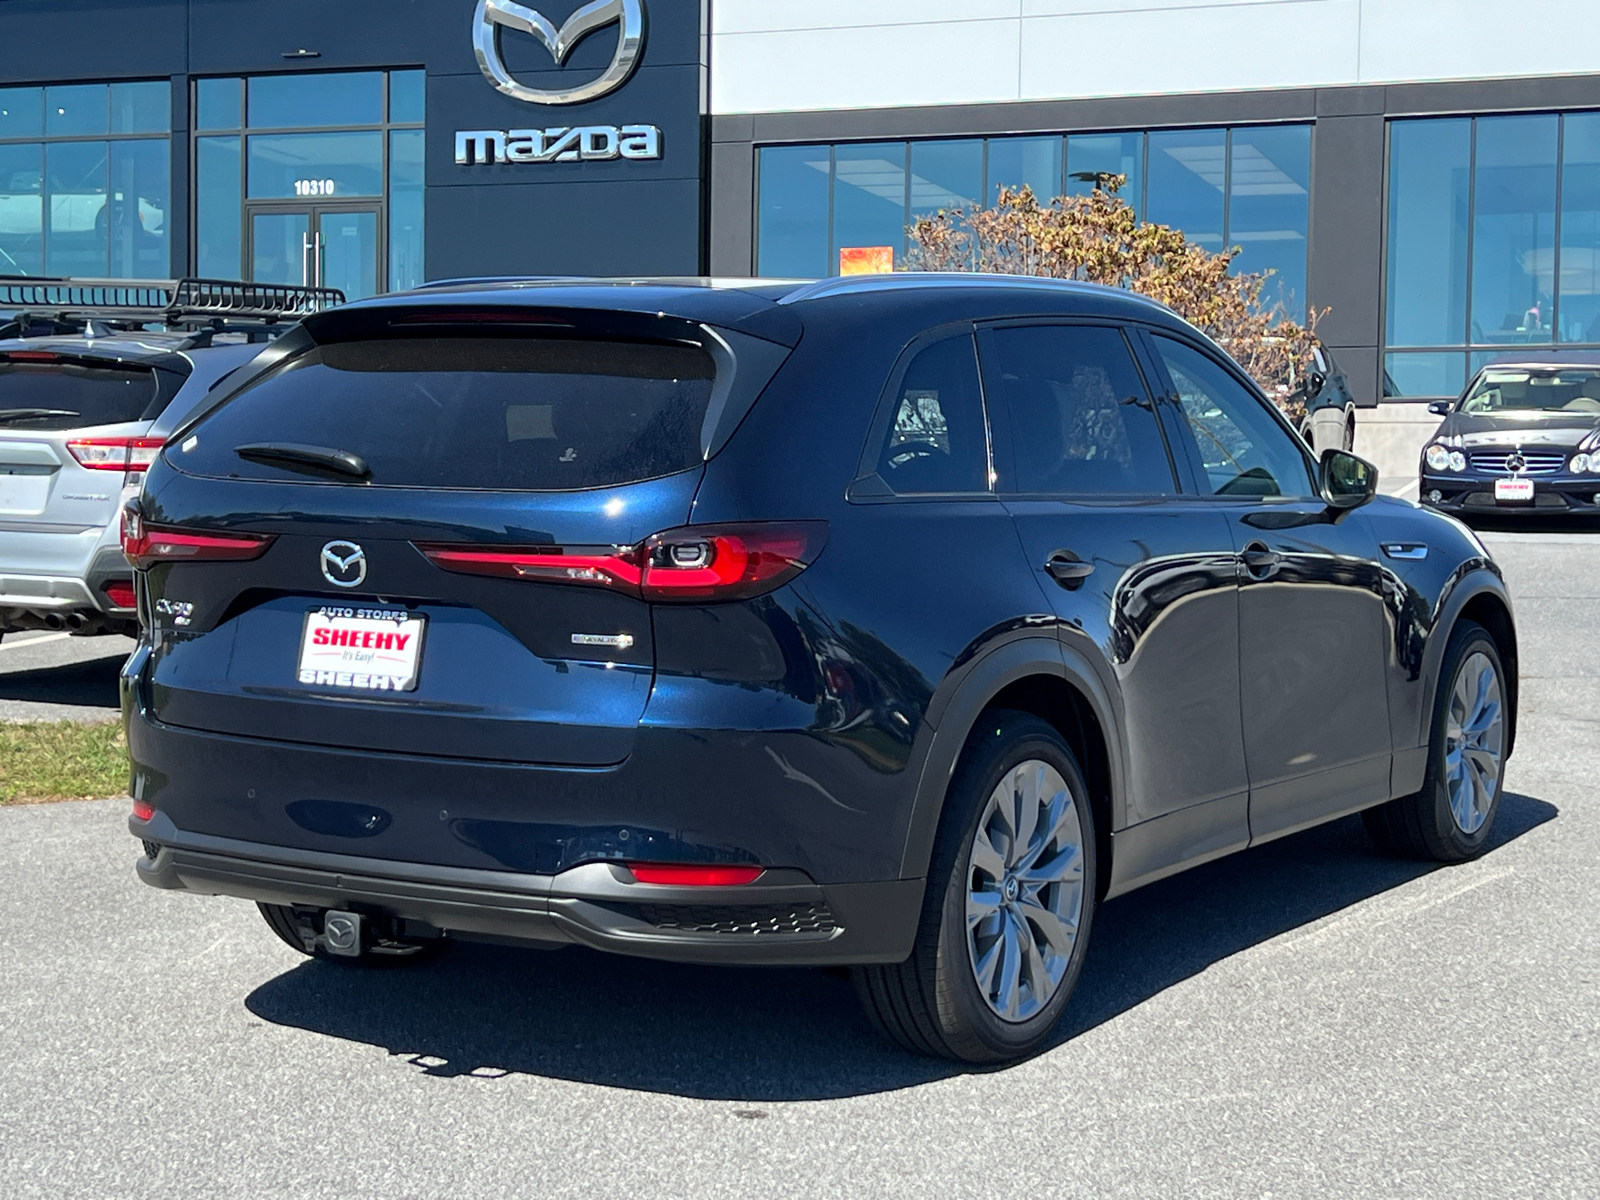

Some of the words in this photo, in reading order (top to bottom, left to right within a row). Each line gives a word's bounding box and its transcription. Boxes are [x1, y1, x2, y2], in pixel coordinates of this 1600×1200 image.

[294, 179, 335, 196] 10310
[319, 606, 354, 618] AUTO
[356, 607, 408, 621] STORES
[313, 627, 411, 651] SHEEHY
[342, 649, 353, 661] It's
[355, 650, 375, 664] Easy!
[299, 669, 408, 691] SHEEHY
